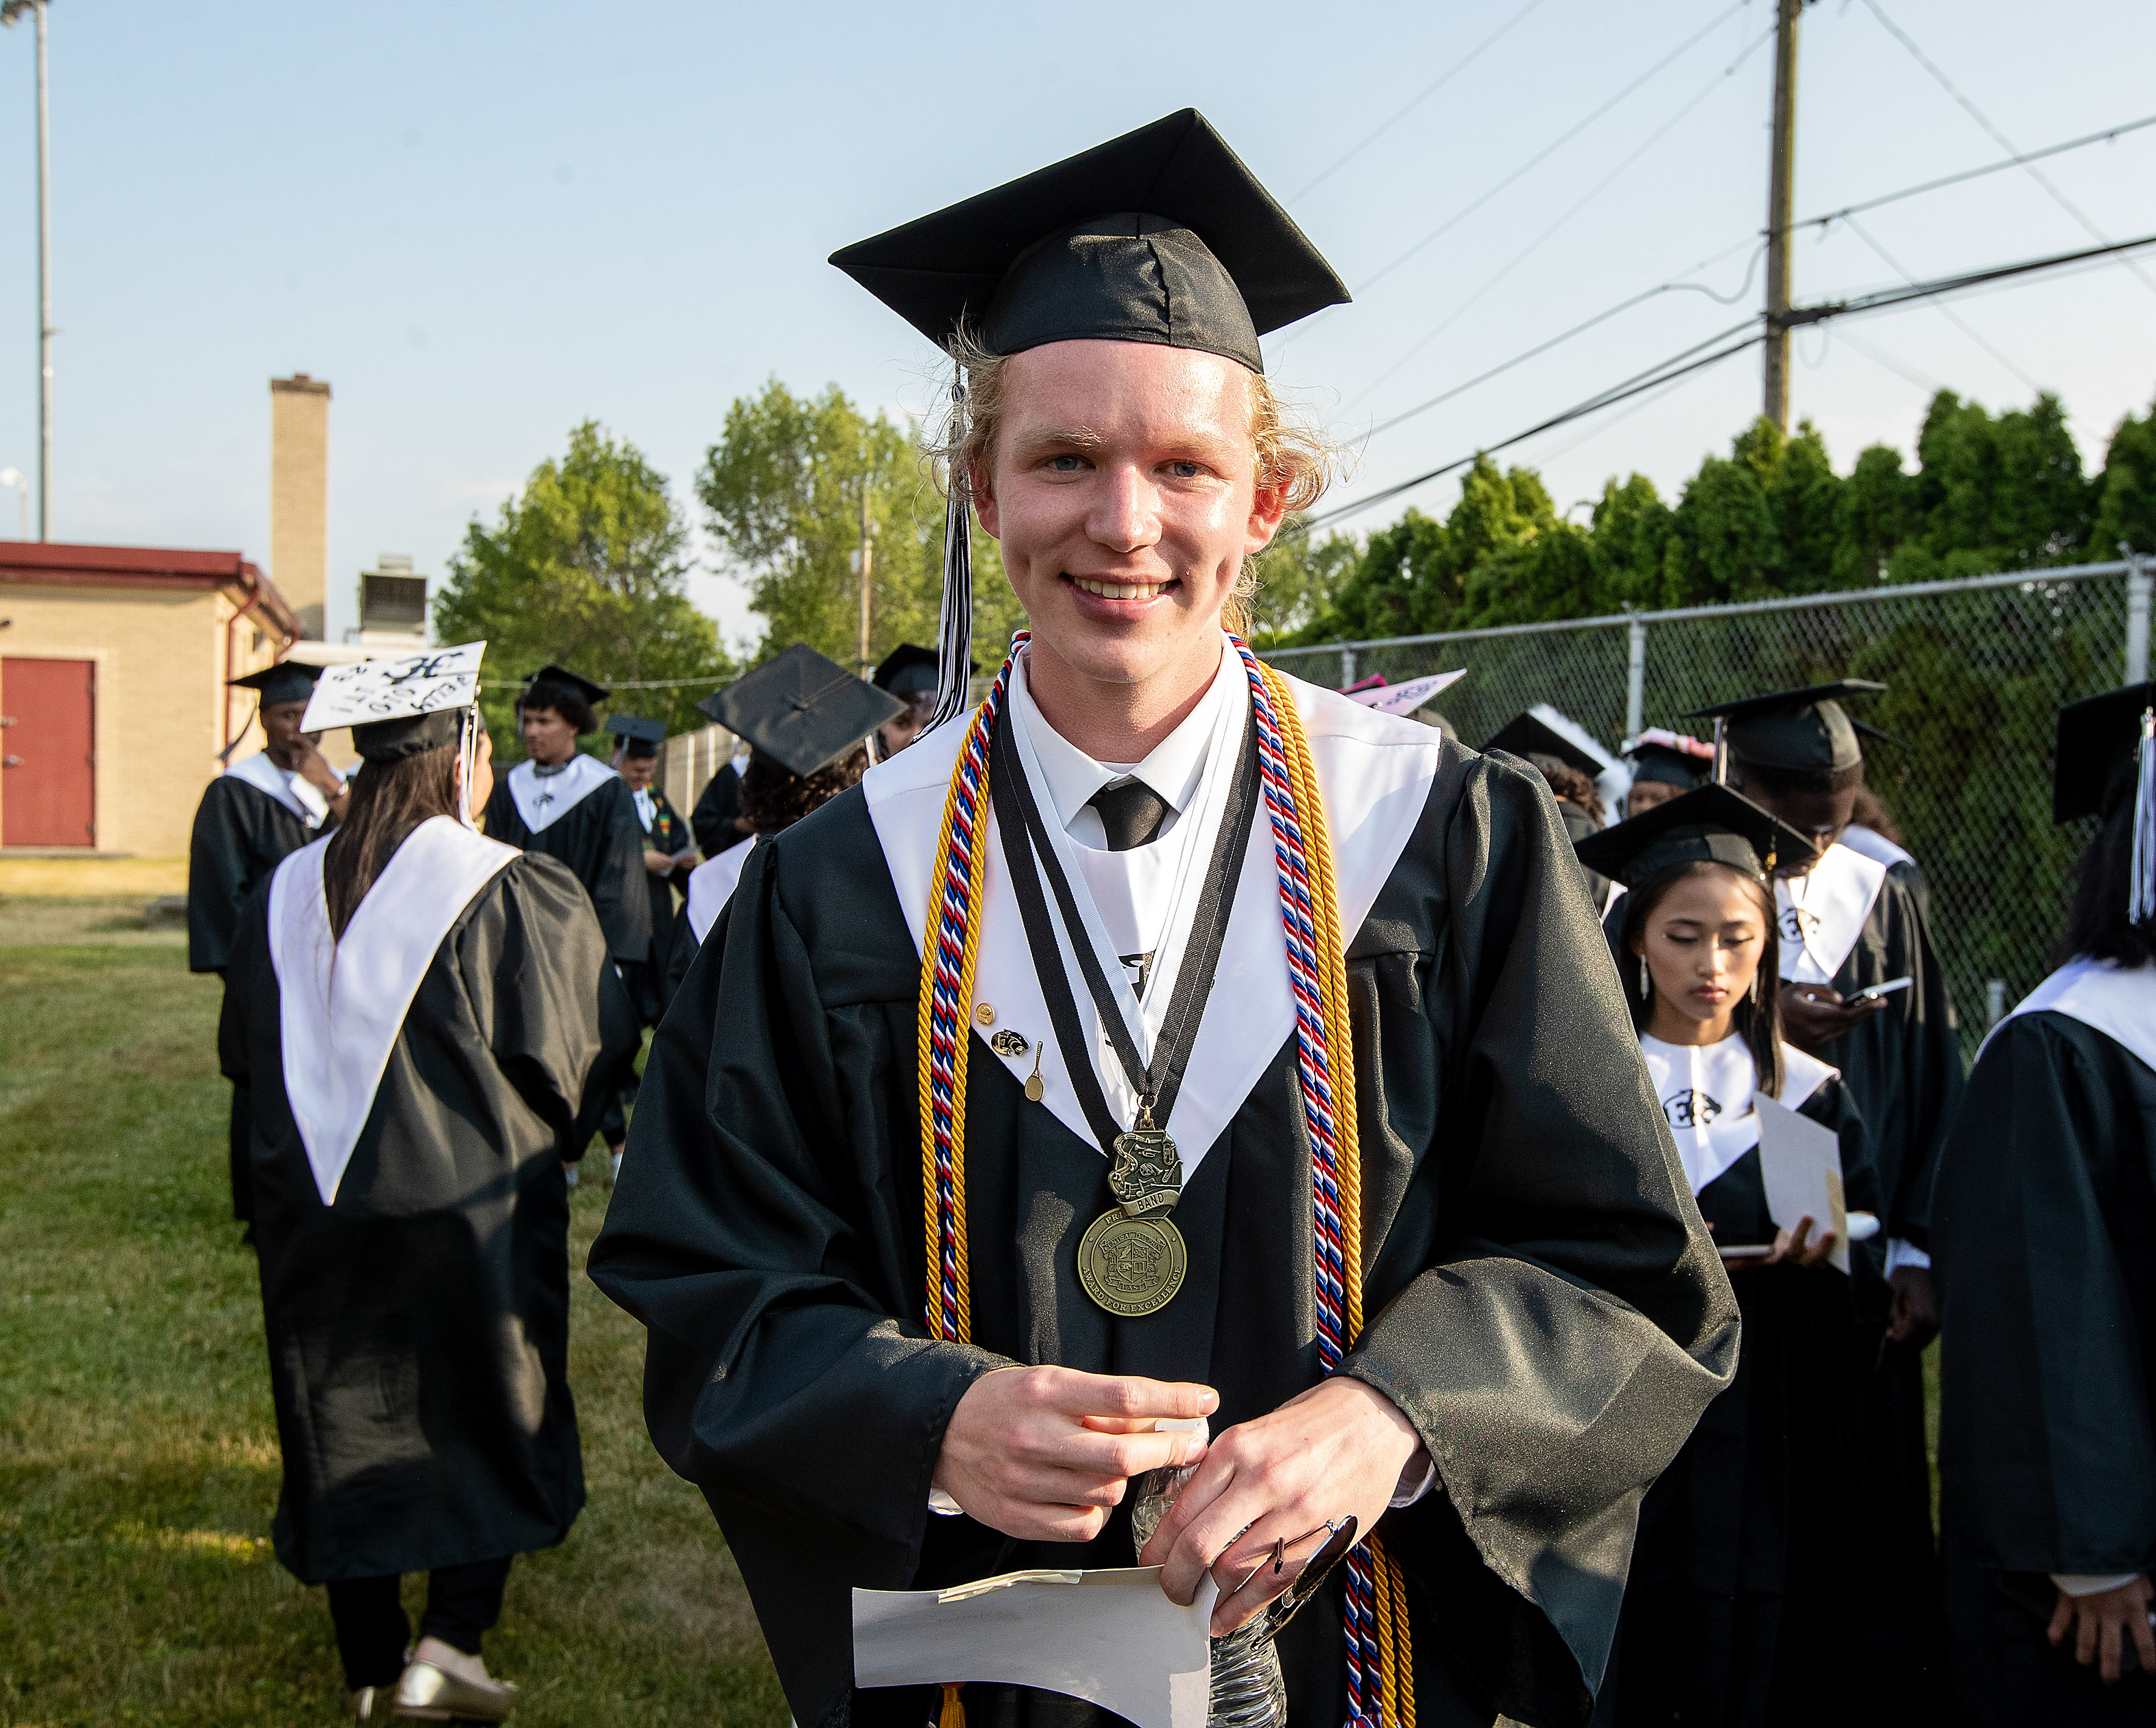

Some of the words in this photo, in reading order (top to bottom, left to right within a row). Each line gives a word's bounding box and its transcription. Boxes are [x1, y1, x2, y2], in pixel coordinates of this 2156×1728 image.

[1137, 1193, 1164, 1211] BAND
[1103, 1232, 1131, 1251] CENTRAL
[1135, 1233, 1162, 1251] DAUPHIN
[1083, 1267, 1105, 1300] AWARD
[1106, 1298, 1127, 1312] FOR
[1130, 1266, 1182, 1312] EXCELLENCE
